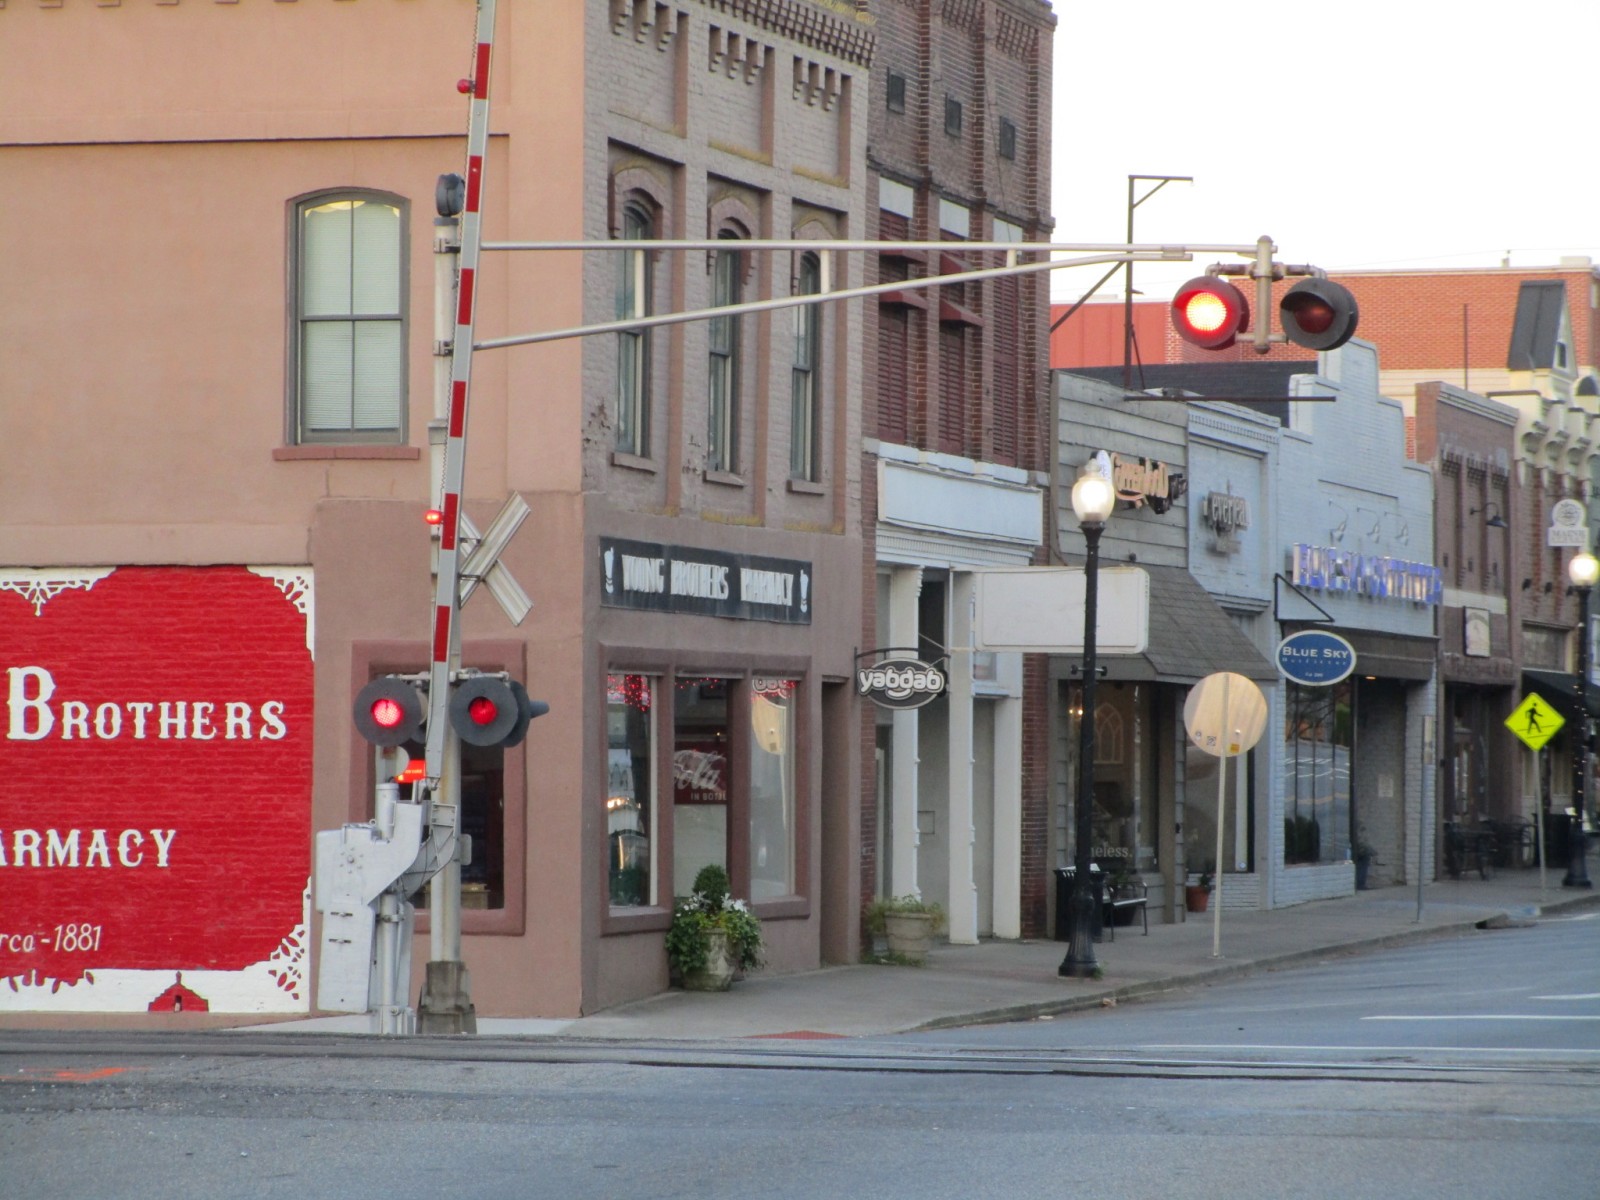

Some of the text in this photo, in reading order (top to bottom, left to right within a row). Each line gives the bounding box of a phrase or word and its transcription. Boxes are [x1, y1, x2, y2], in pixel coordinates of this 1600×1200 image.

[1282, 646, 1349, 659] BLUE SKY
[858, 666, 944, 695] yabdab
[6, 665, 287, 741] BROTHERS
